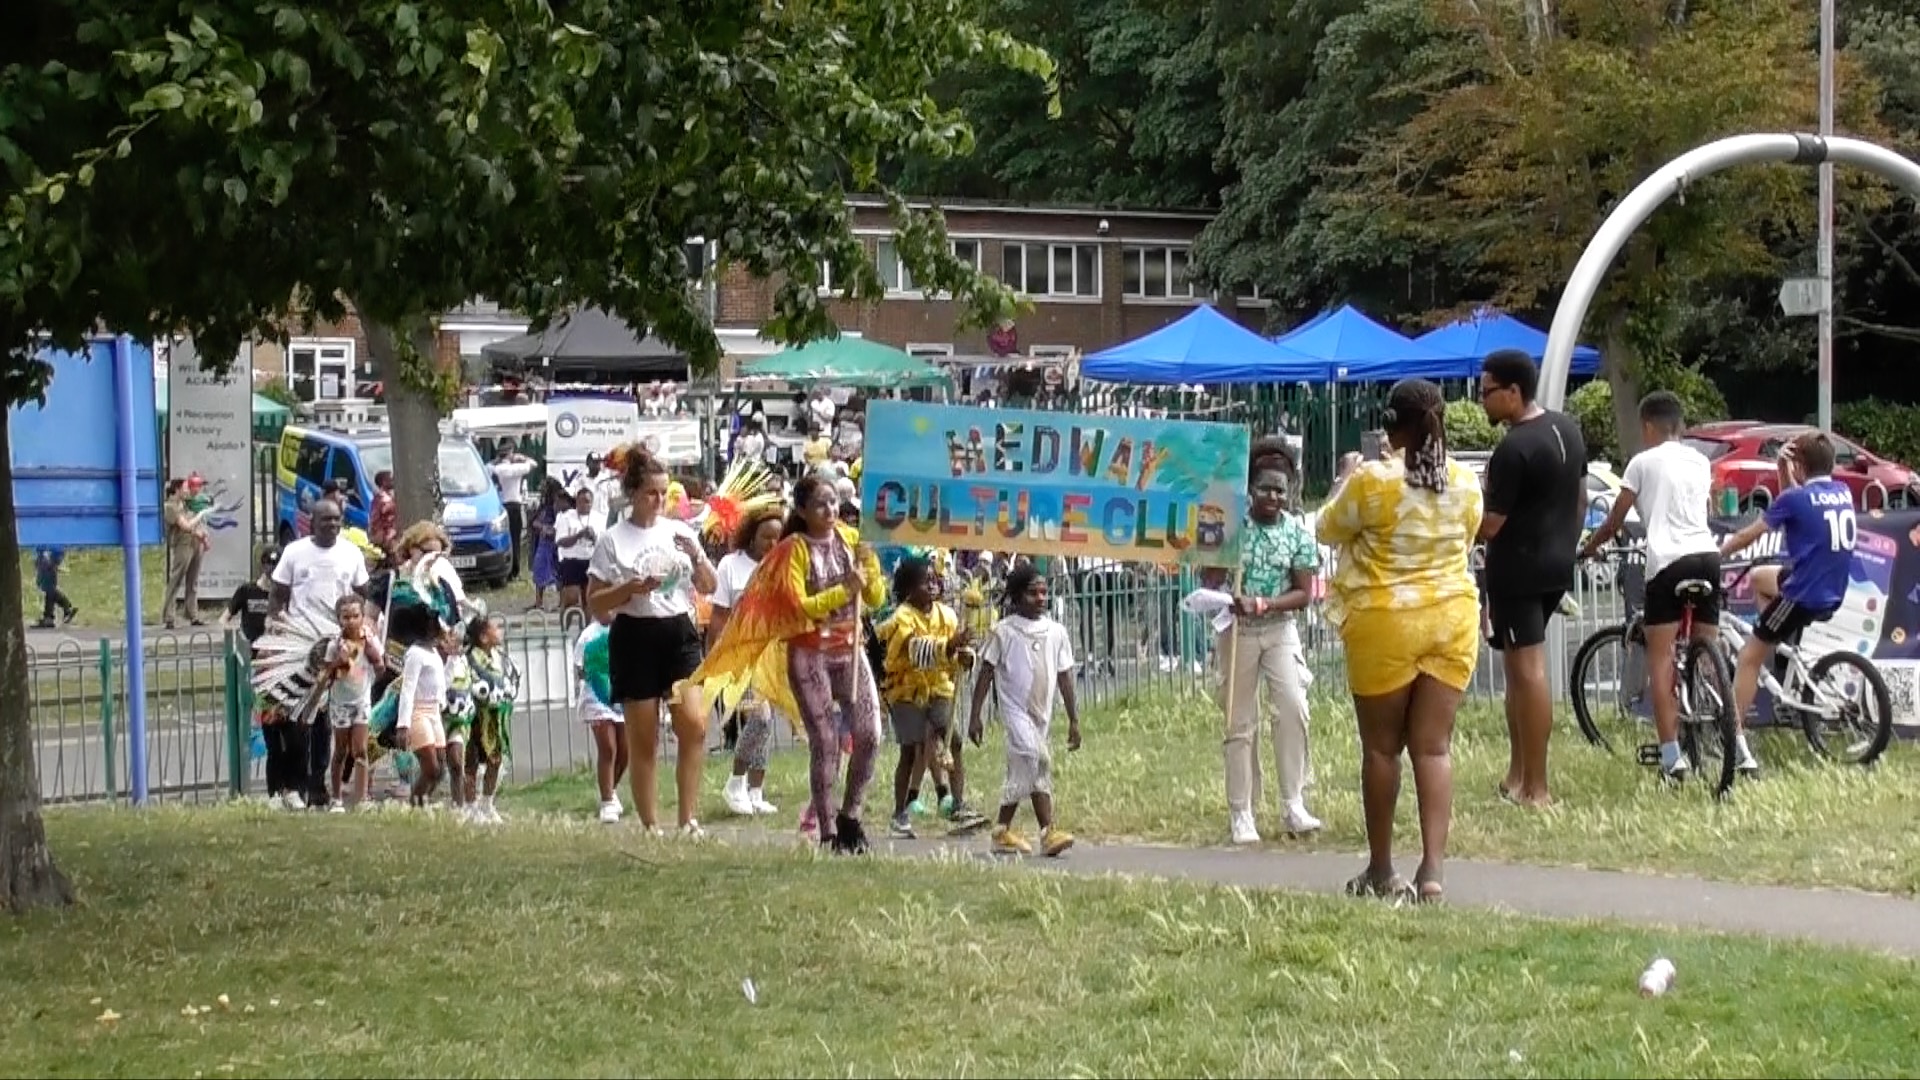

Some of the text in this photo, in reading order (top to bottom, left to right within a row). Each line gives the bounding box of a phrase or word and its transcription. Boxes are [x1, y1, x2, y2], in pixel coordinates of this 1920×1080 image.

[183, 409, 235, 420] Reception
[185, 425, 222, 436] Victory
[206, 441, 239, 451] Apollo
[945, 422, 1169, 491] MEDWAY
[874, 480, 1226, 551] CULTURE CLUB
[1823, 509, 1857, 552] 10
